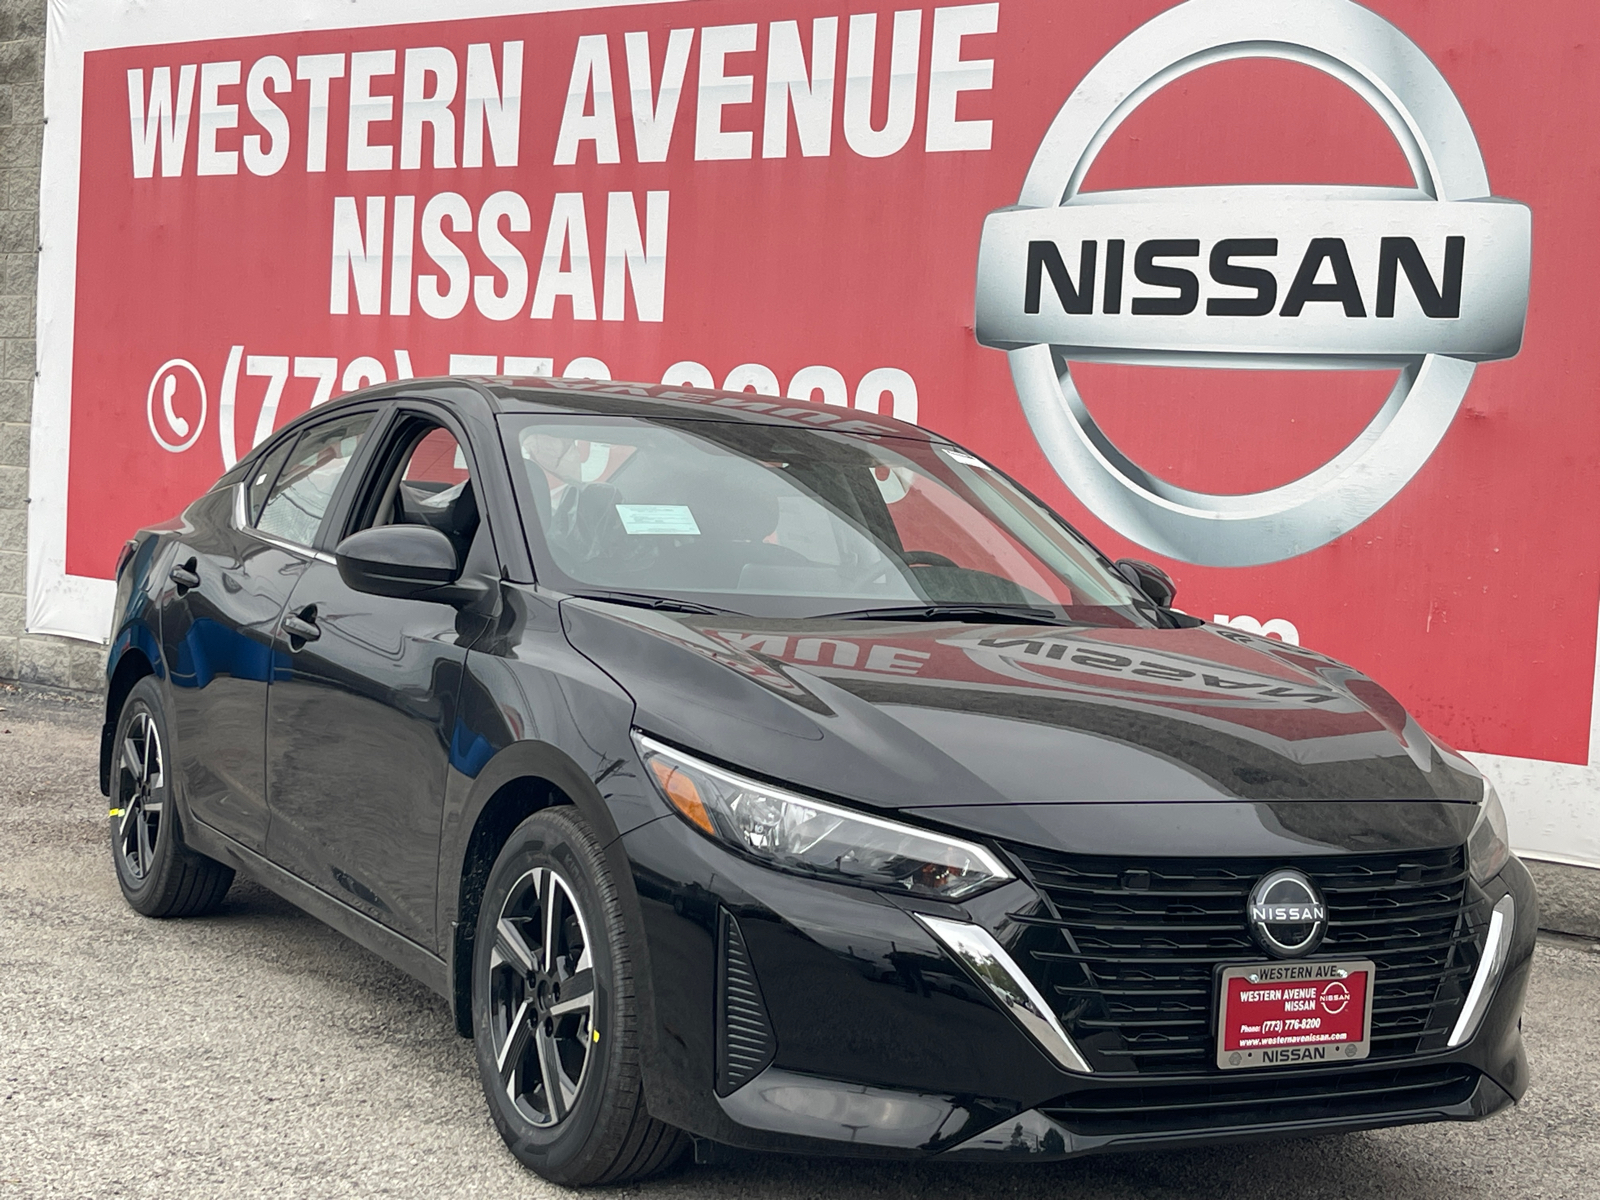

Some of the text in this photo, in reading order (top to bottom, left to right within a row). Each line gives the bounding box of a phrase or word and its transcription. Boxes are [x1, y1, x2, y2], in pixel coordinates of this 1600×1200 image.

[127, 2, 999, 179] WESTERN AVENUE
[329, 190, 670, 323] NISSAN
[1024, 235, 1465, 319] NISSAN
[1252, 907, 1324, 920] NISSAN
[1260, 966, 1313, 980] WESTERN
[1240, 988, 1317, 1002] WESTERN AVENUE
[1284, 1000, 1316, 1012] NISSAN
[1240, 1018, 1321, 1034] Phone: (773) 776-8200
[1239, 1033, 1347, 1046] www.westernavenissan.com
[1262, 1047, 1325, 1063] NISSAN
